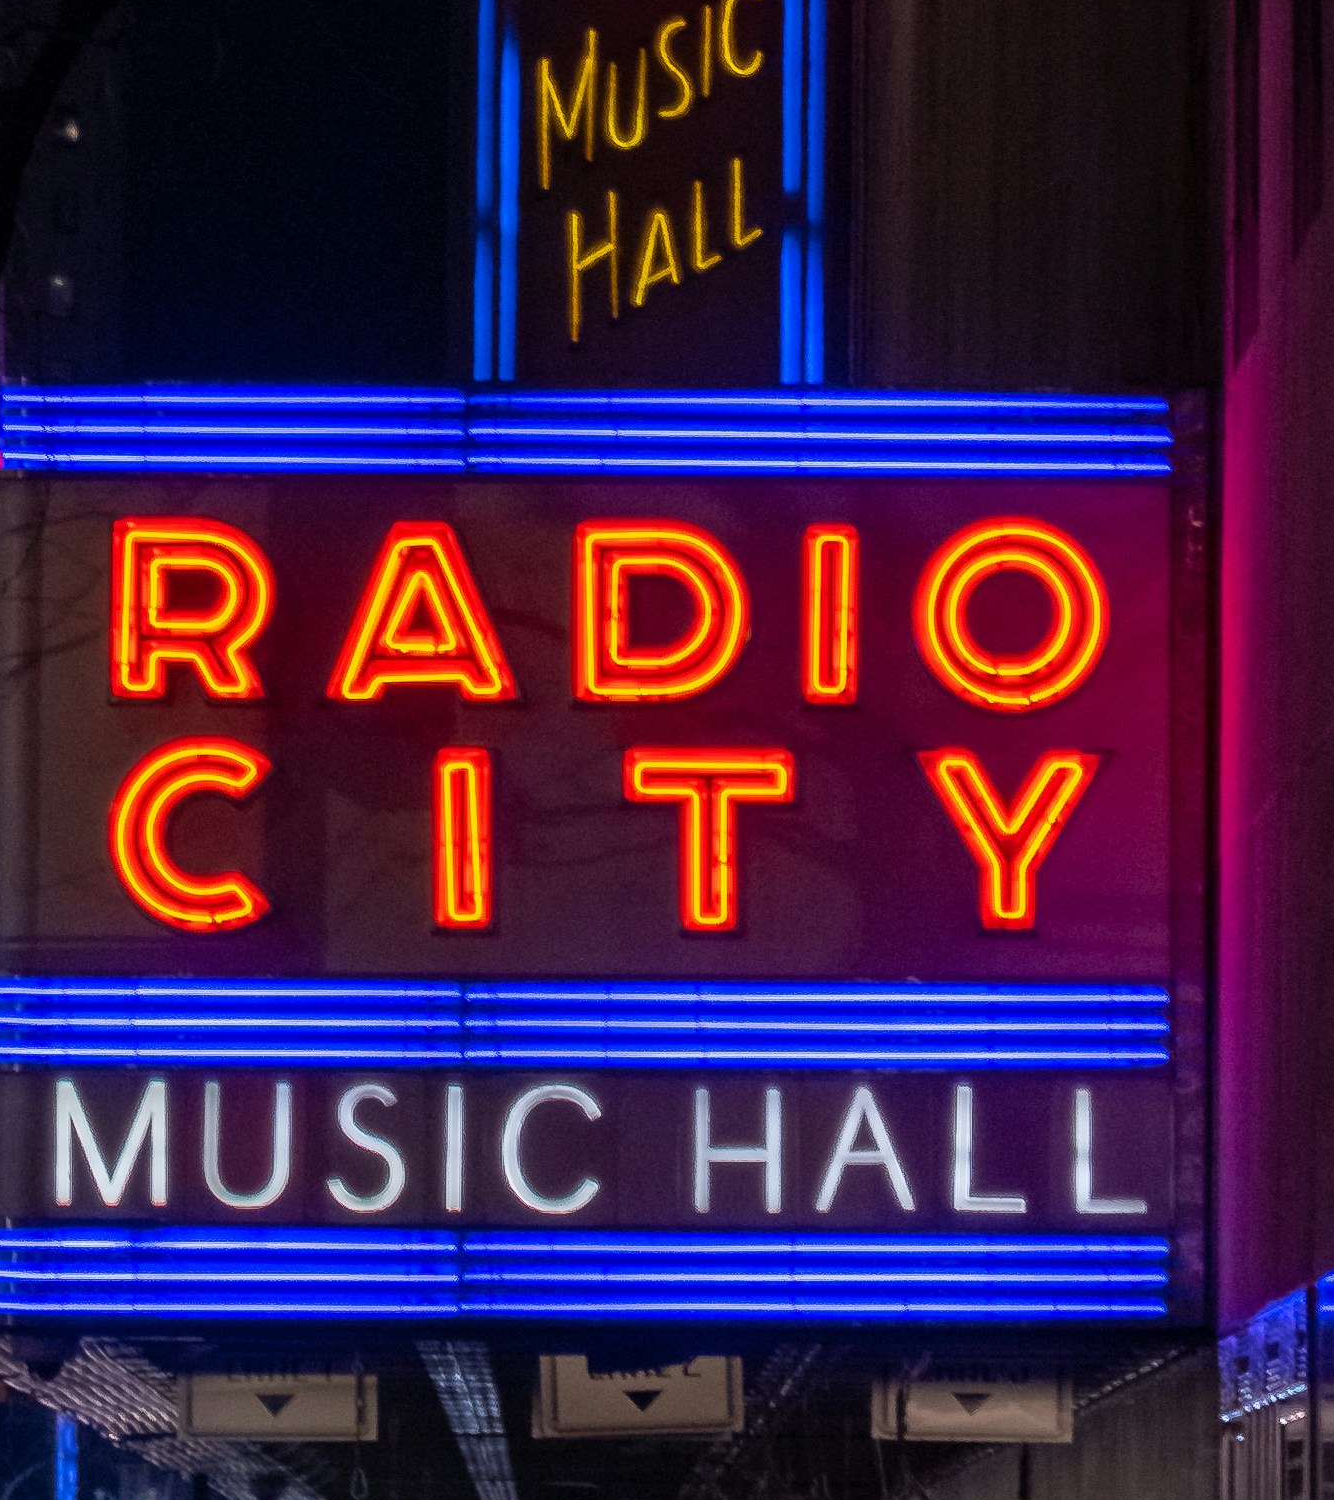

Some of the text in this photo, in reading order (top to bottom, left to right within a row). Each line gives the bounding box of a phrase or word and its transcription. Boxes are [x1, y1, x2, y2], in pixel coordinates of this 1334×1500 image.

[567, 157, 763, 342] HALL
[110, 516, 1110, 712] RADIO
[109, 737, 1097, 932] CITY
[54, 1079, 1147, 1214] MUSIC HALL
